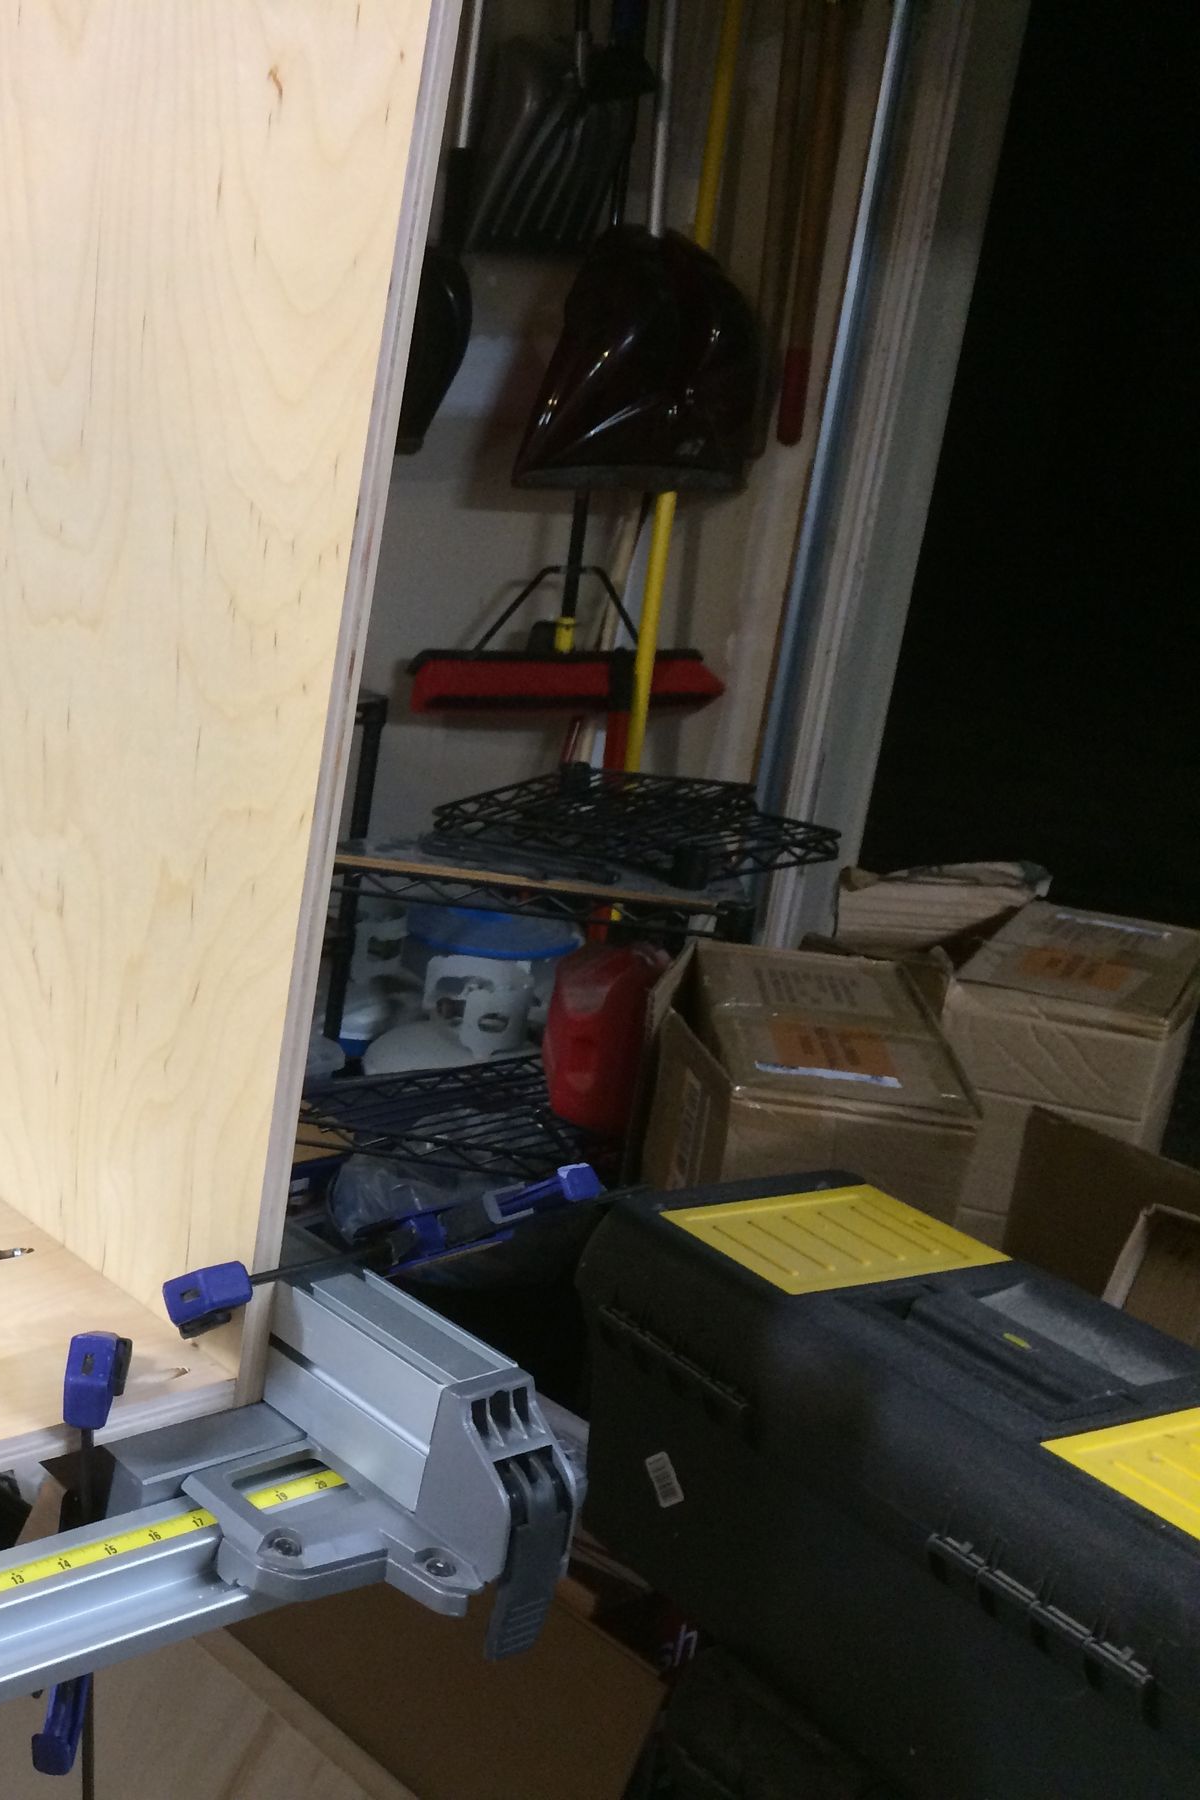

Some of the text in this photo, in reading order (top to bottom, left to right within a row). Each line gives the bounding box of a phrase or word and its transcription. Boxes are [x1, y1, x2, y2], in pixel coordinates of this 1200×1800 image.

[11, 1574, 25, 1585] 13
[58, 1559, 72, 1570] 14
[104, 1545, 118, 1556] 15
[148, 1531, 162, 1542] 16
[192, 1517, 204, 1527] 17
[275, 1492, 288, 1501] 19
[315, 1480, 328, 1489] 20
